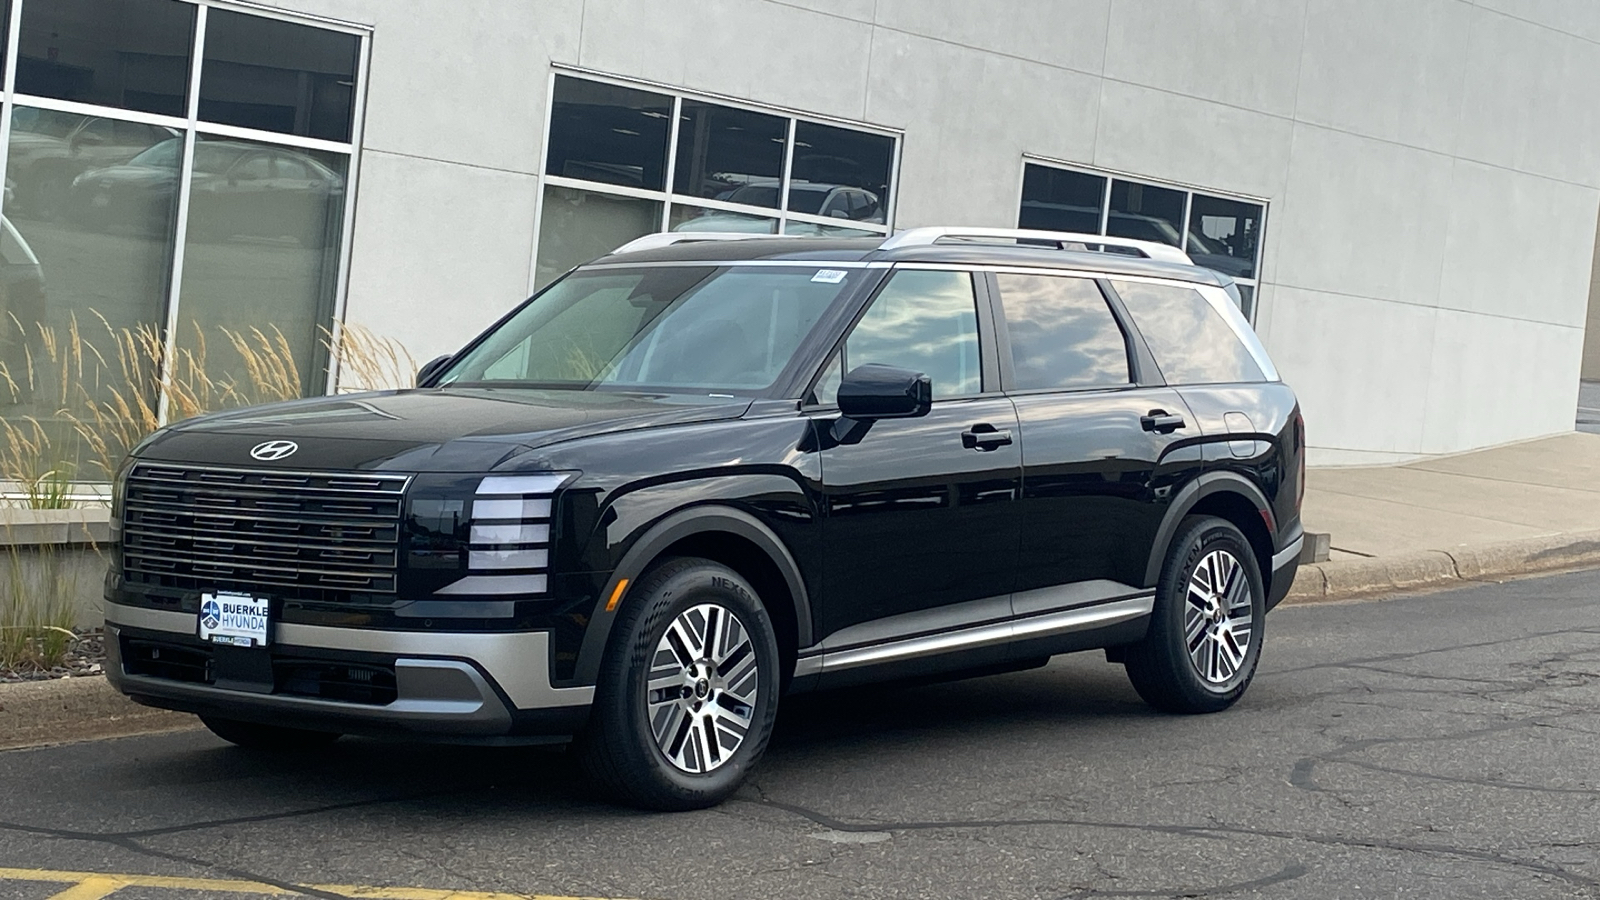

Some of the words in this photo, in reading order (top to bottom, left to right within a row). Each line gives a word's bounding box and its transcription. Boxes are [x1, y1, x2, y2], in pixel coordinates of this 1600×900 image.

[1178, 544, 1200, 593] NEXEN
[223, 603, 268, 617] BUERKLE
[222, 615, 266, 630] HYUNDA
